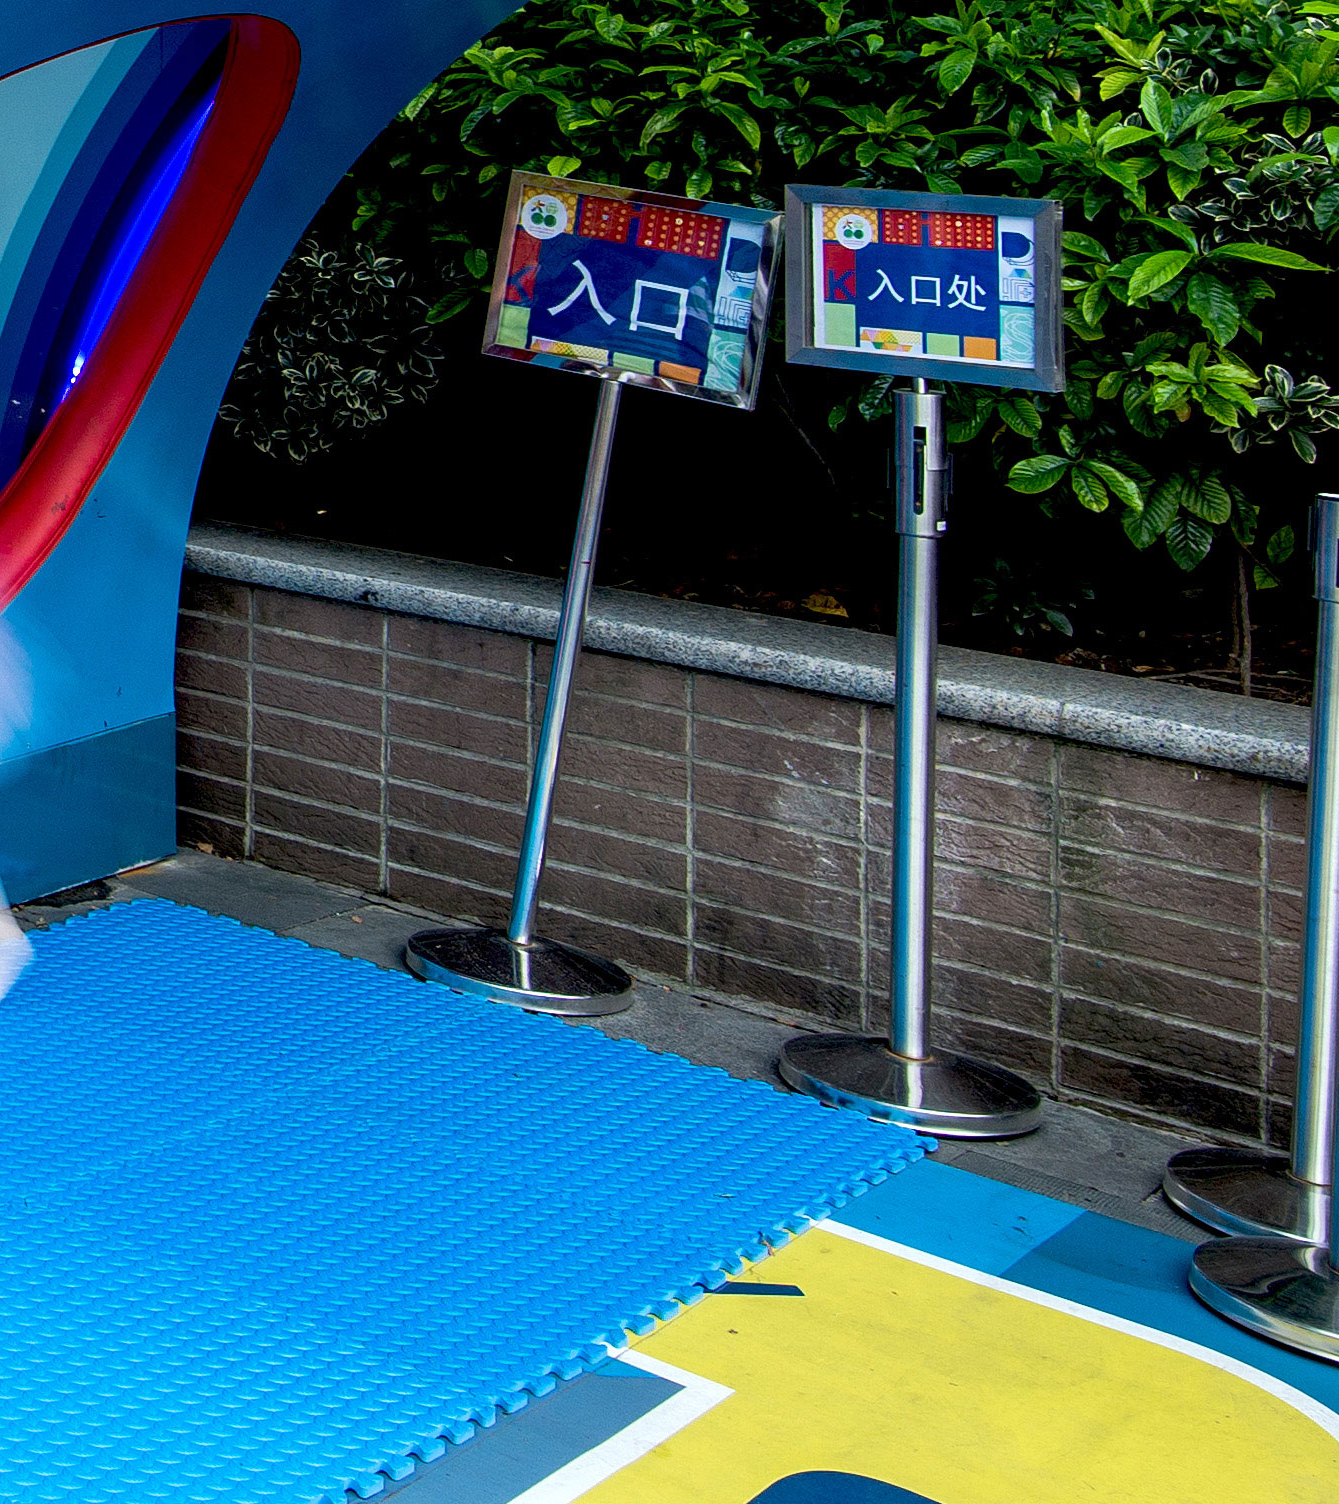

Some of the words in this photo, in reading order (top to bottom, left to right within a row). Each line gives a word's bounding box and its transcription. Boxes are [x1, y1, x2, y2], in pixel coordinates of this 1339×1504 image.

[547, 259, 690, 341] 入口
[867, 268, 987, 312] 入口处
